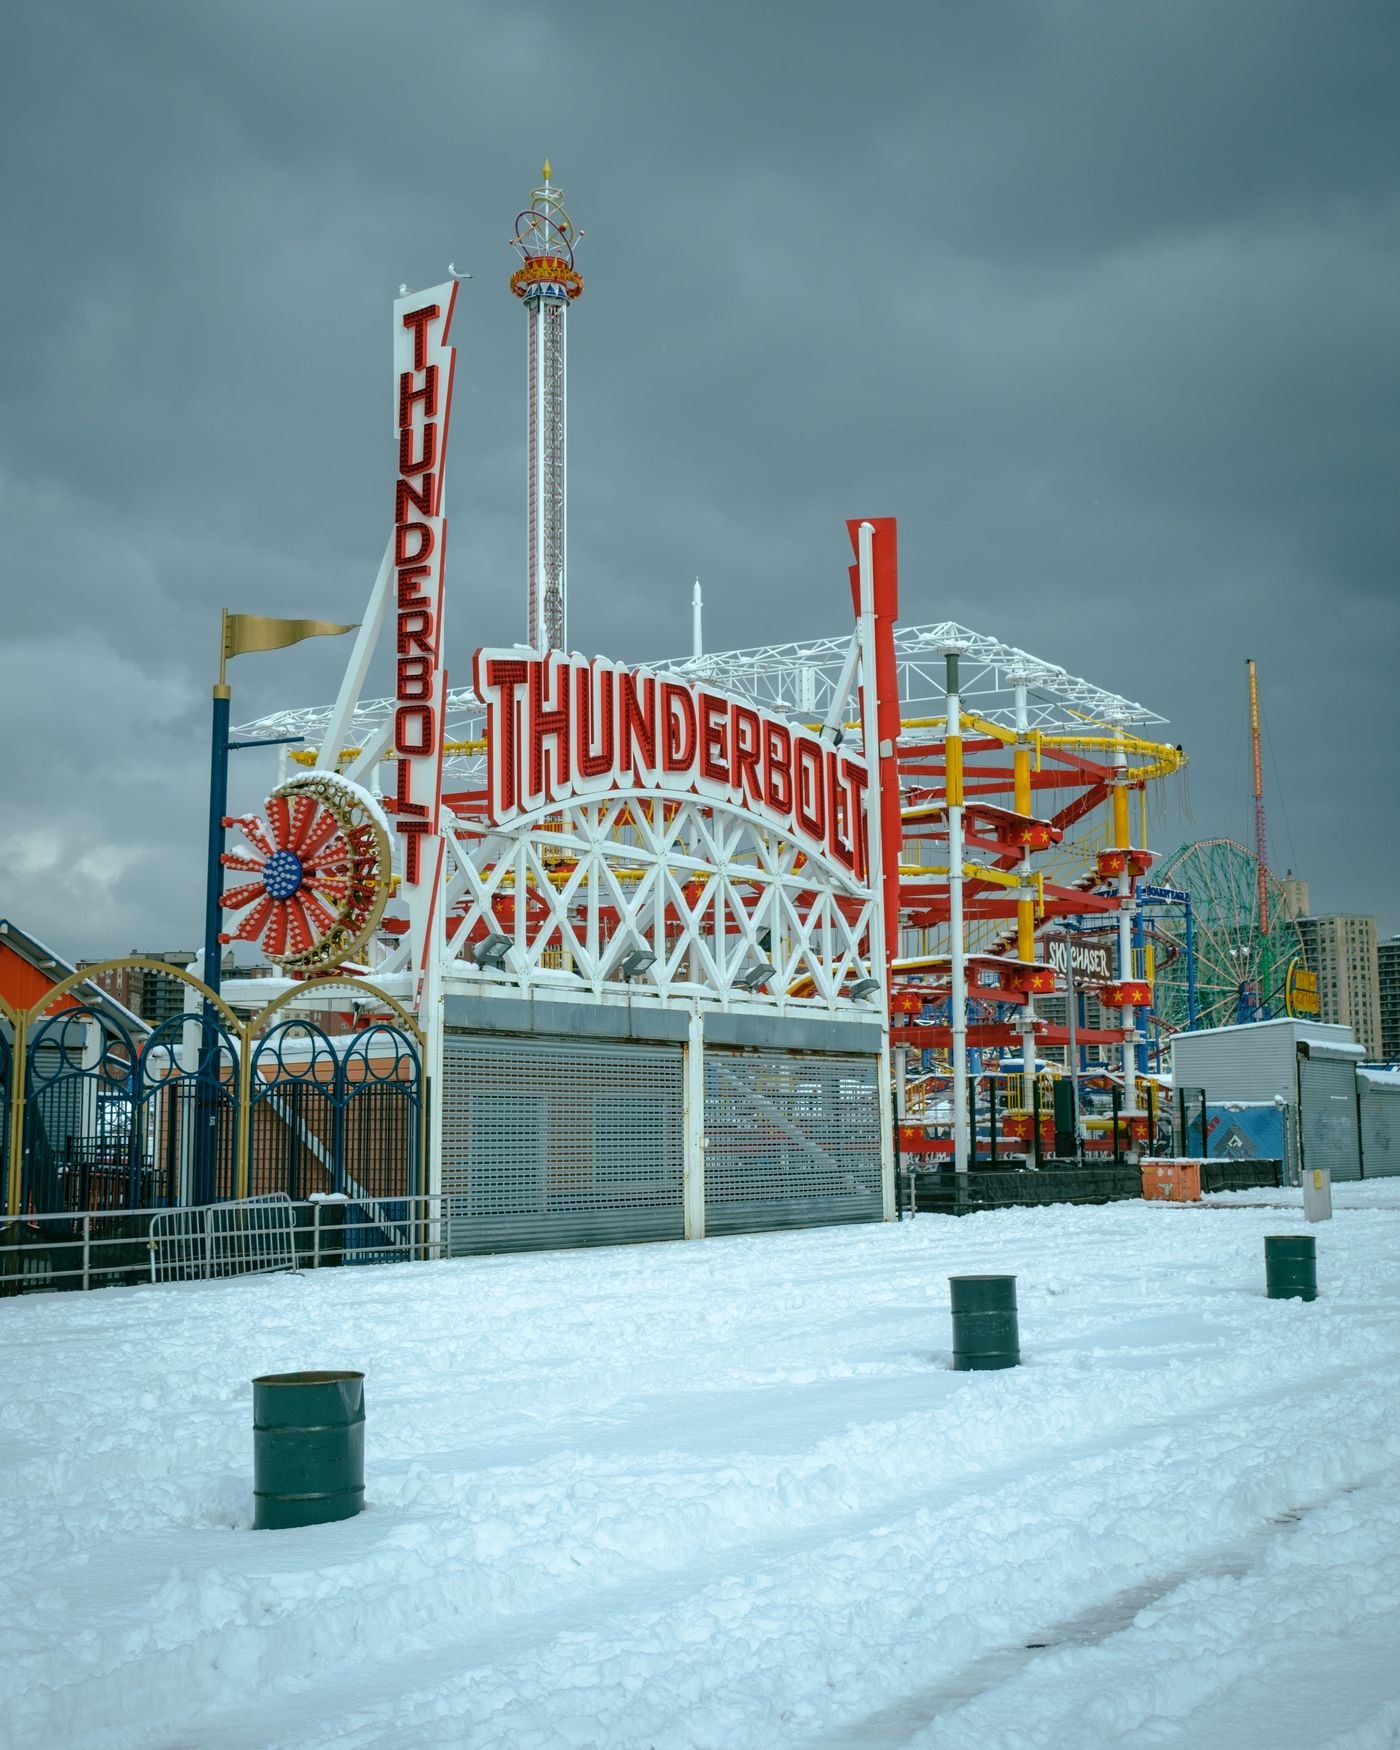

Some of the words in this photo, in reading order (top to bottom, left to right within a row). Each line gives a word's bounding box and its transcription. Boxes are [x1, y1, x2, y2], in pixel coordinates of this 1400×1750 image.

[395, 304, 440, 885] THUNDERBOLT
[484, 656, 869, 883] THUNDERBOLT
[1049, 941, 1069, 973] SKY
[1070, 946, 1110, 977] CHASER
